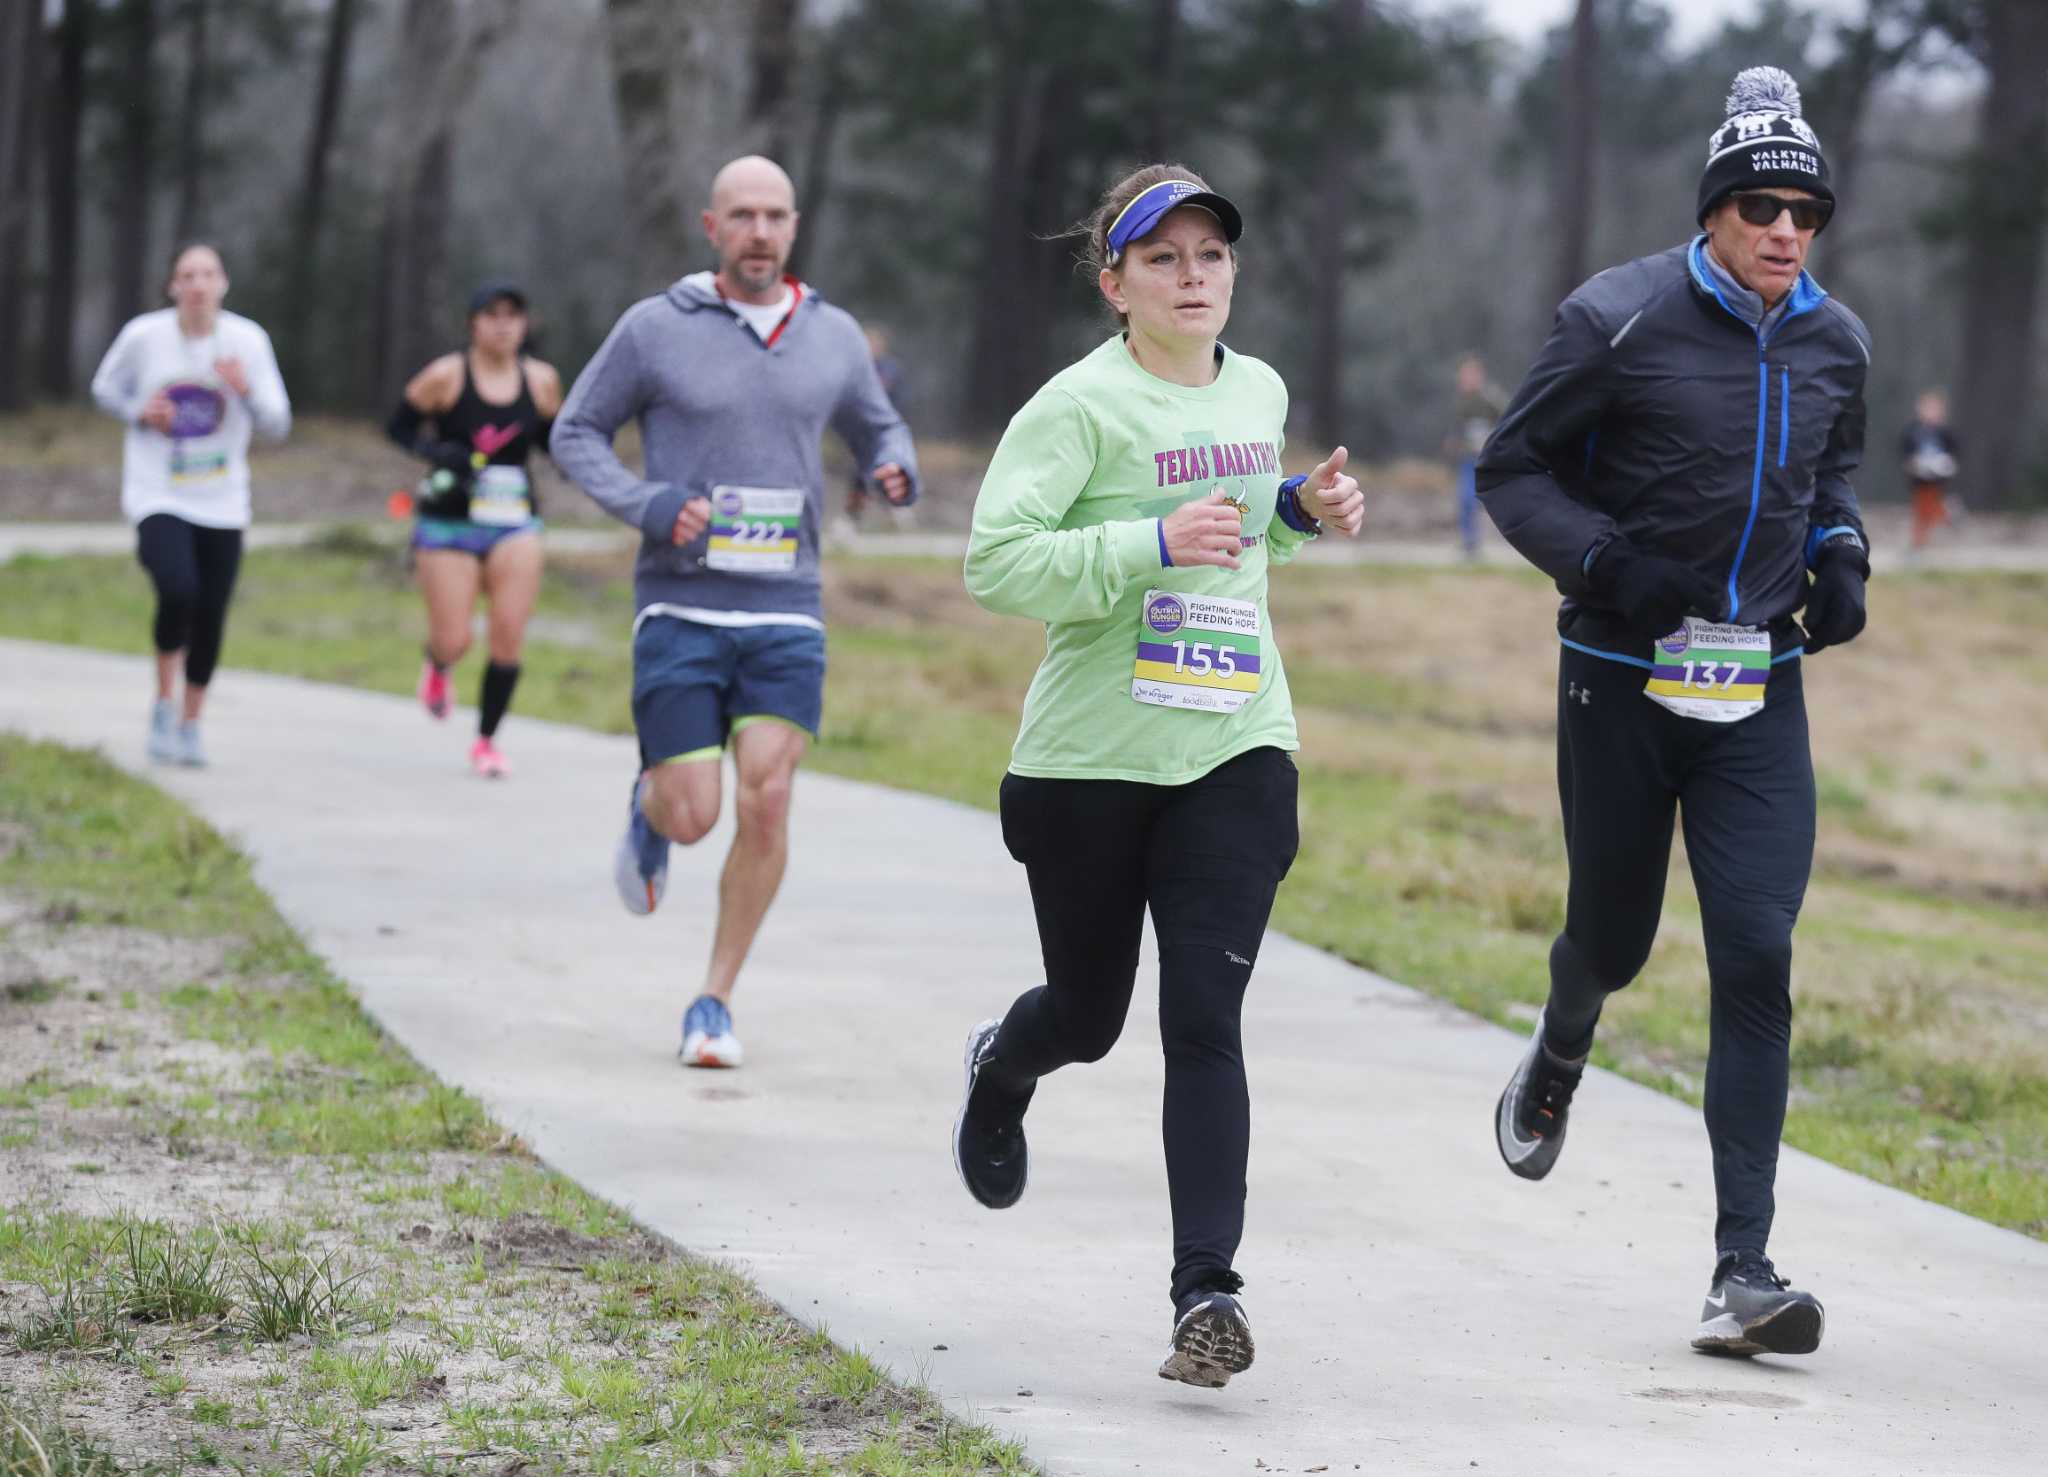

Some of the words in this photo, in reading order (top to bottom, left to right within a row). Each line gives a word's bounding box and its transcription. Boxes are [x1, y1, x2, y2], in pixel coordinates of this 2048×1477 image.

[1752, 150, 1818, 167] VALKYRIE
[1752, 160, 1818, 176] VALHALLA
[1155, 446, 1208, 487] TEXAS
[731, 520, 784, 547] 222
[1190, 603, 1230, 615] FIGHTING
[1231, 608, 1256, 619] HUNGER
[1190, 613, 1233, 626] FEEDING
[1695, 625, 1732, 634] FIGHTING
[1695, 633, 1735, 644] FEEDING
[1172, 640, 1236, 679] 155
[1682, 660, 1742, 691] 137
